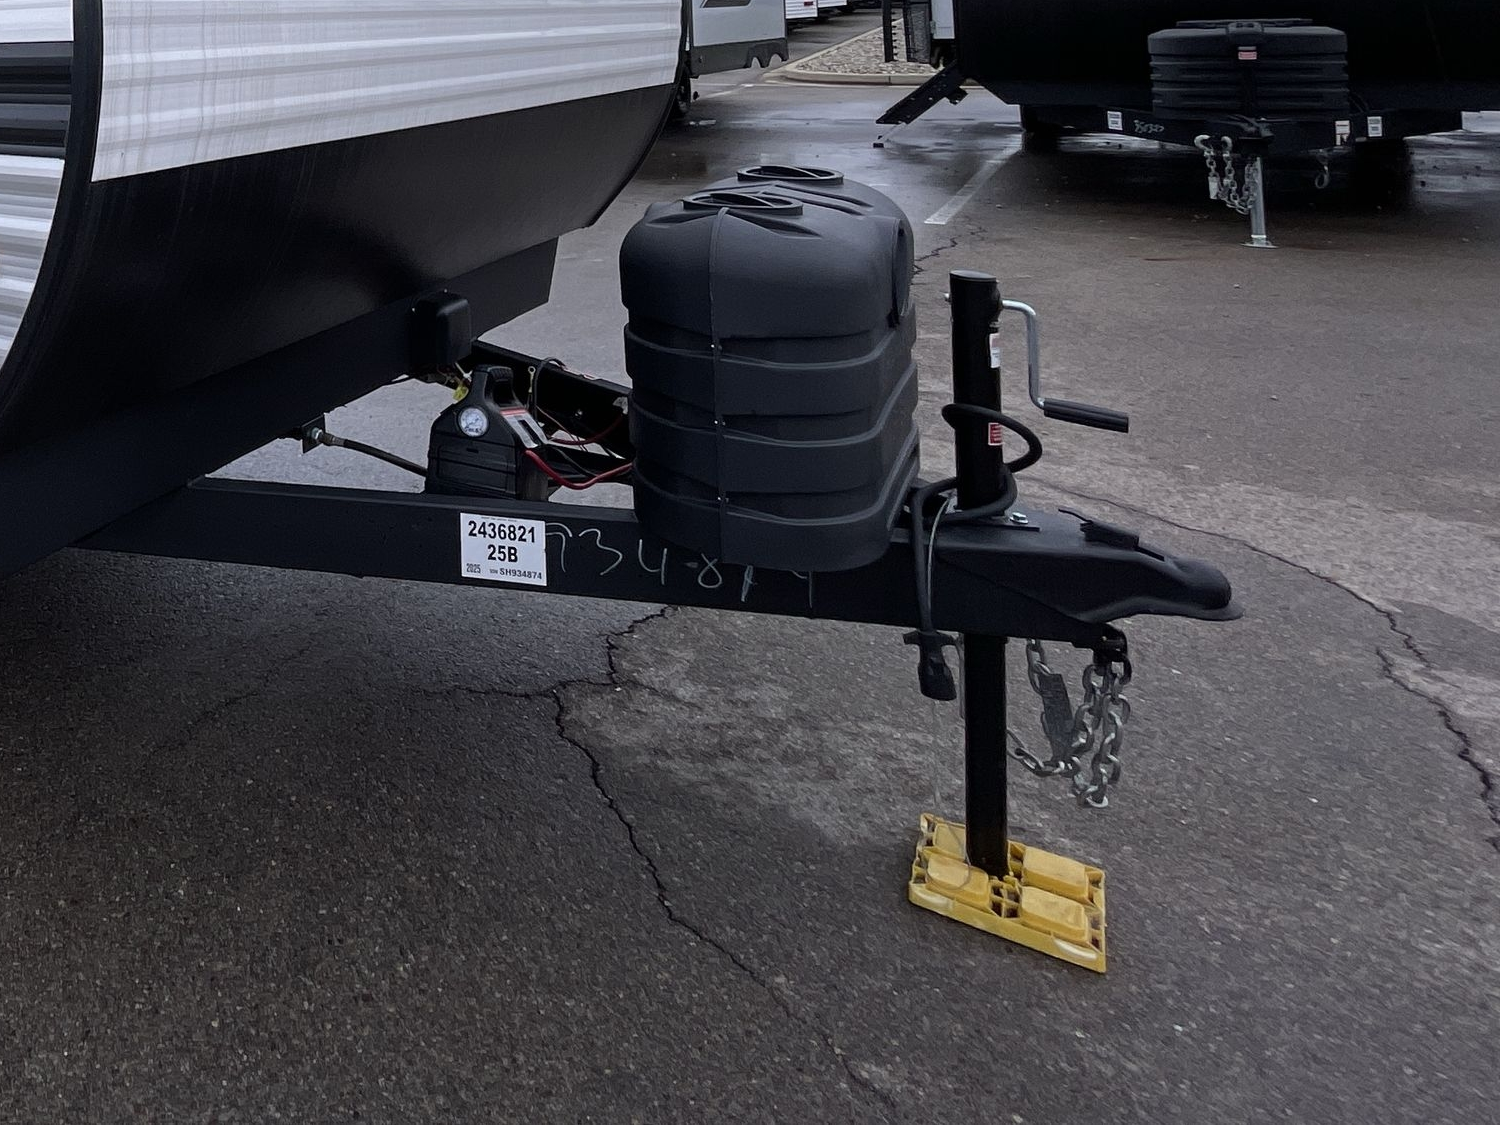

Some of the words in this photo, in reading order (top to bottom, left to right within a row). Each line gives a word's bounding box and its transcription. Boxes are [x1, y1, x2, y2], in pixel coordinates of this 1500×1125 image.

[468, 520, 535, 543] 2436821
[487, 544, 518, 563] 25B
[466, 563, 481, 574] 2025
[500, 568, 542, 580] SH934874
